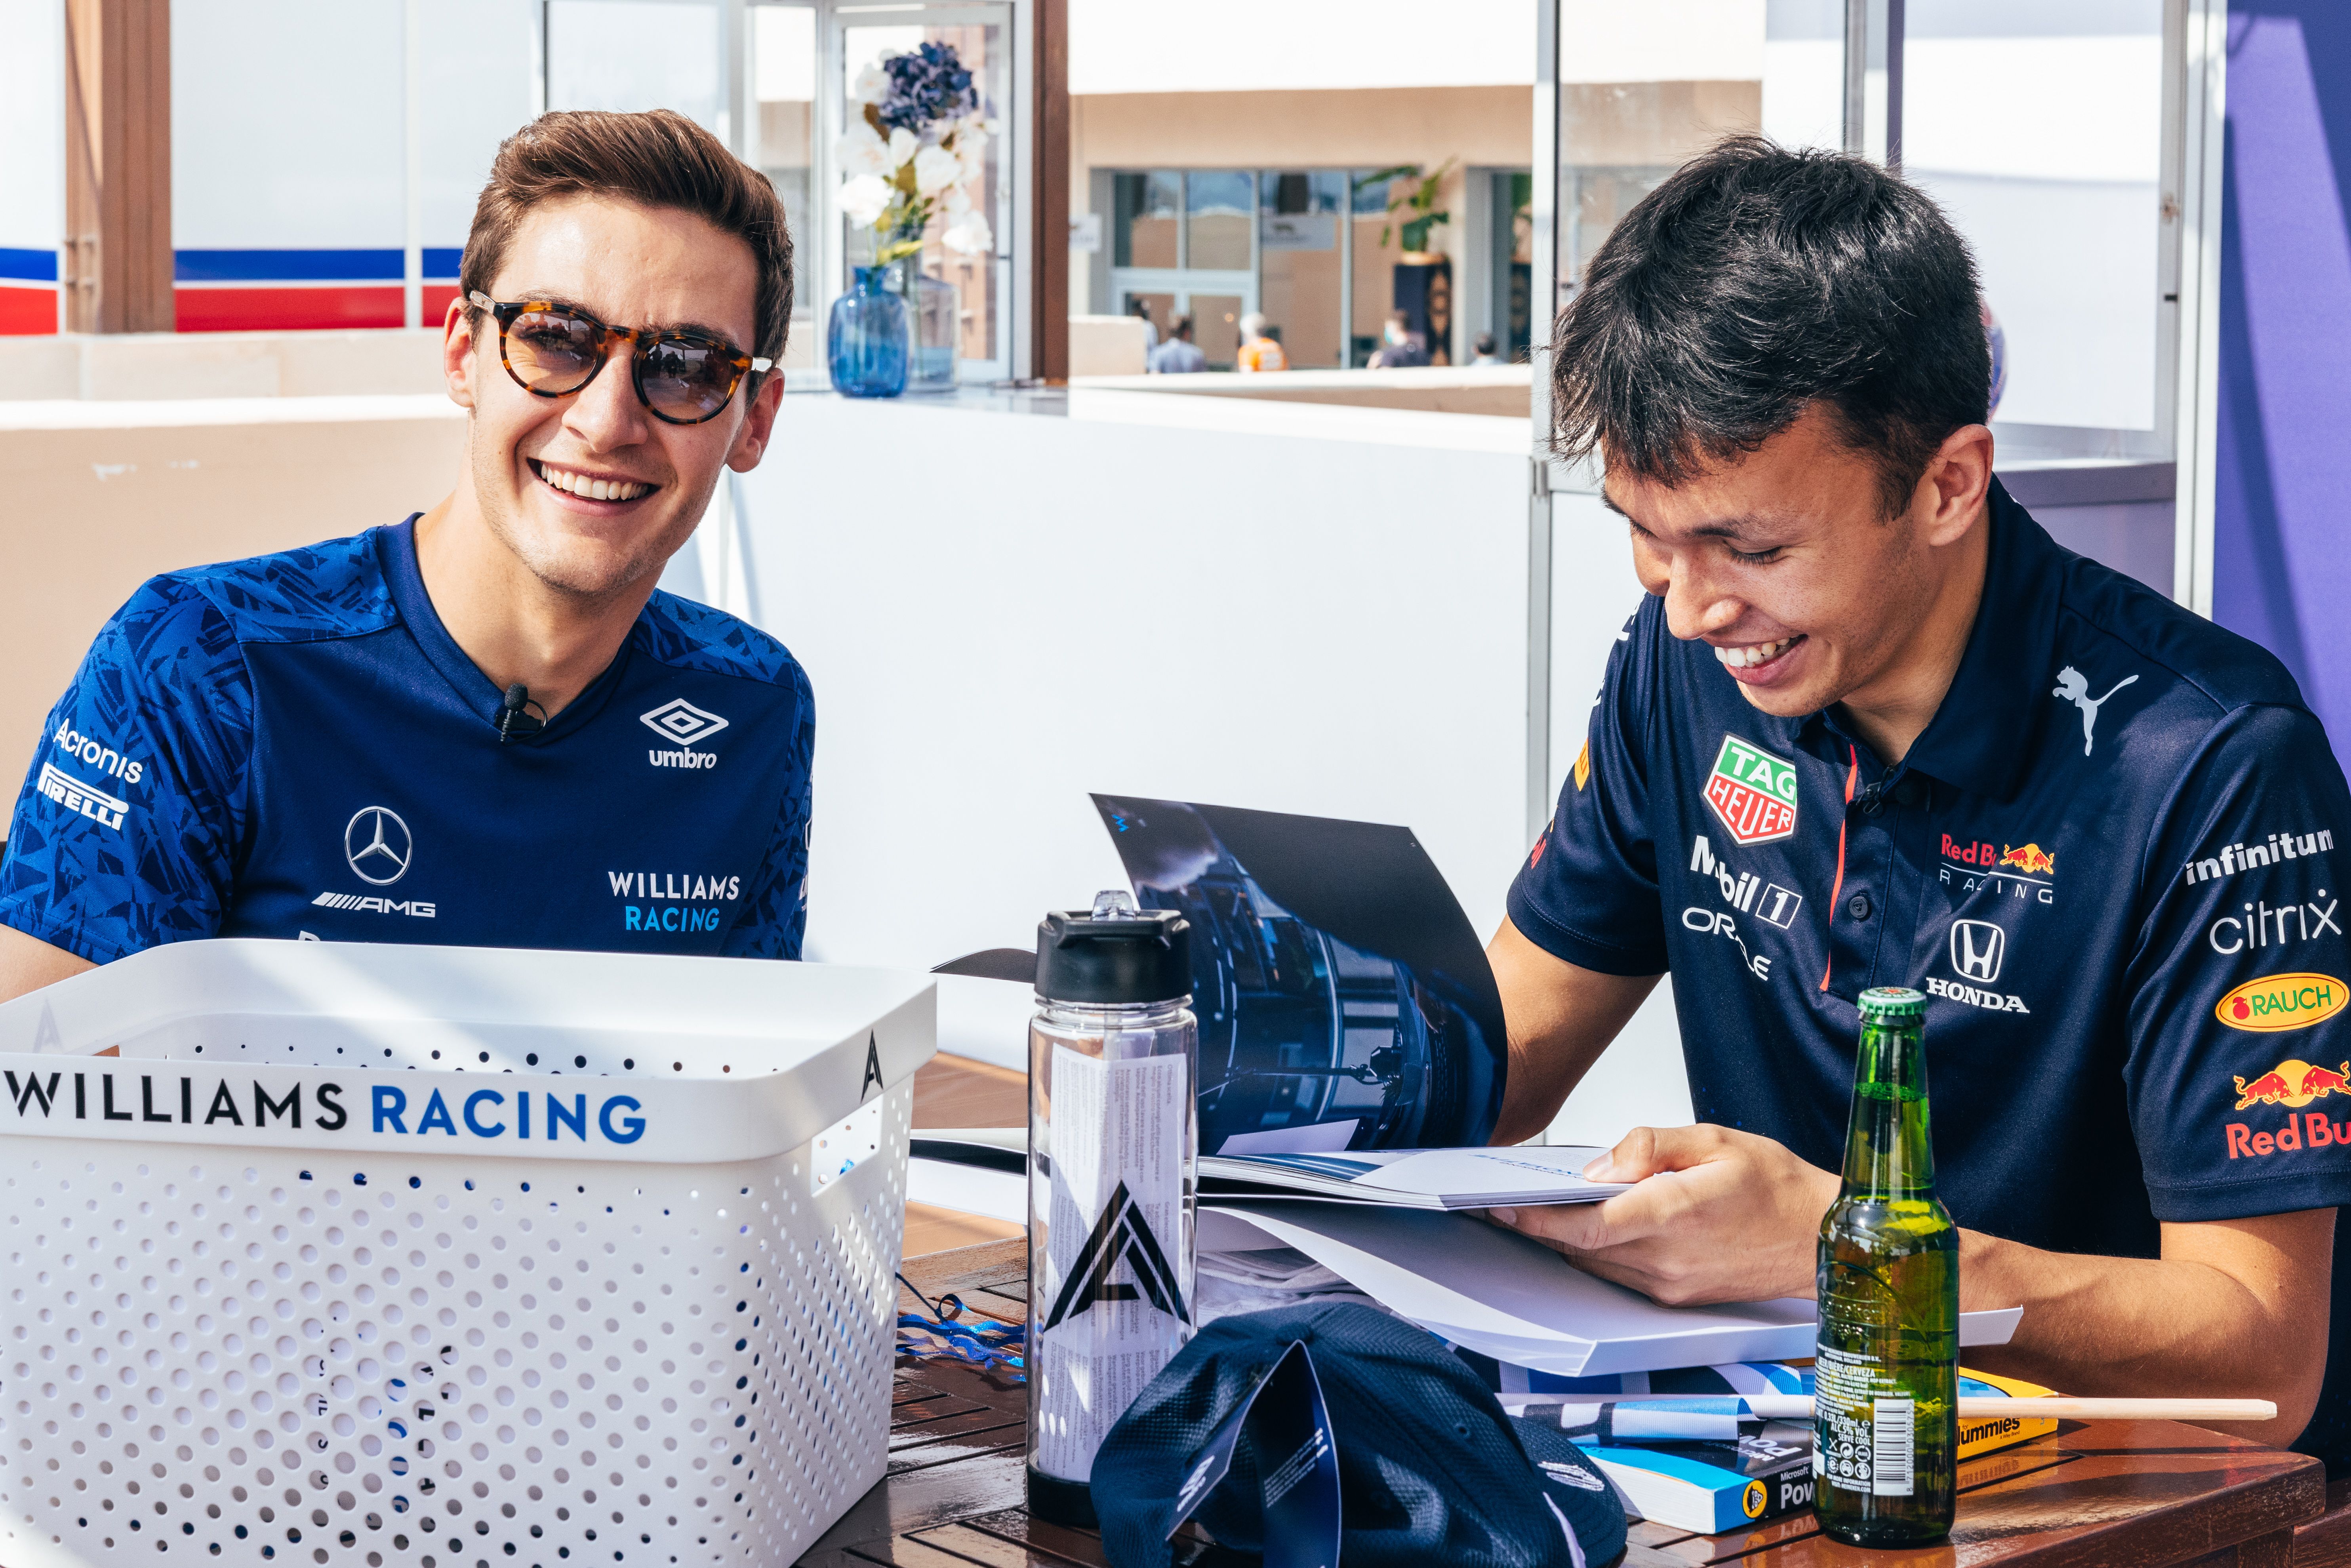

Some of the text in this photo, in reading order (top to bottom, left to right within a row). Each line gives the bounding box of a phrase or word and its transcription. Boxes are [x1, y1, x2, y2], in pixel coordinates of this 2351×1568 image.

[53, 718, 143, 784] Acronis
[648, 747, 717, 769] umbro
[1730, 746, 1797, 800] TAG
[37, 761, 130, 831] PIRELLI
[1712, 779, 1792, 836] HEUER
[1941, 833, 1979, 864] Red
[2185, 828, 2333, 886] infinitum
[608, 871, 740, 901] WILLIAMS
[1690, 835, 1761, 913] Mbil
[360, 897, 436, 918] AMG
[625, 906, 720, 932] RACING
[2209, 889, 2342, 955] citrix
[1926, 977, 2030, 1014] HONDA
[2252, 985, 2332, 1017] RAUCH
[3, 1070, 646, 1144] WILLIAMS RACING
[2225, 1112, 2351, 1160] Red Bu
[1838, 1433, 1871, 1446] SERVE COOL
[1781, 1466, 1810, 1482] Microsoft
